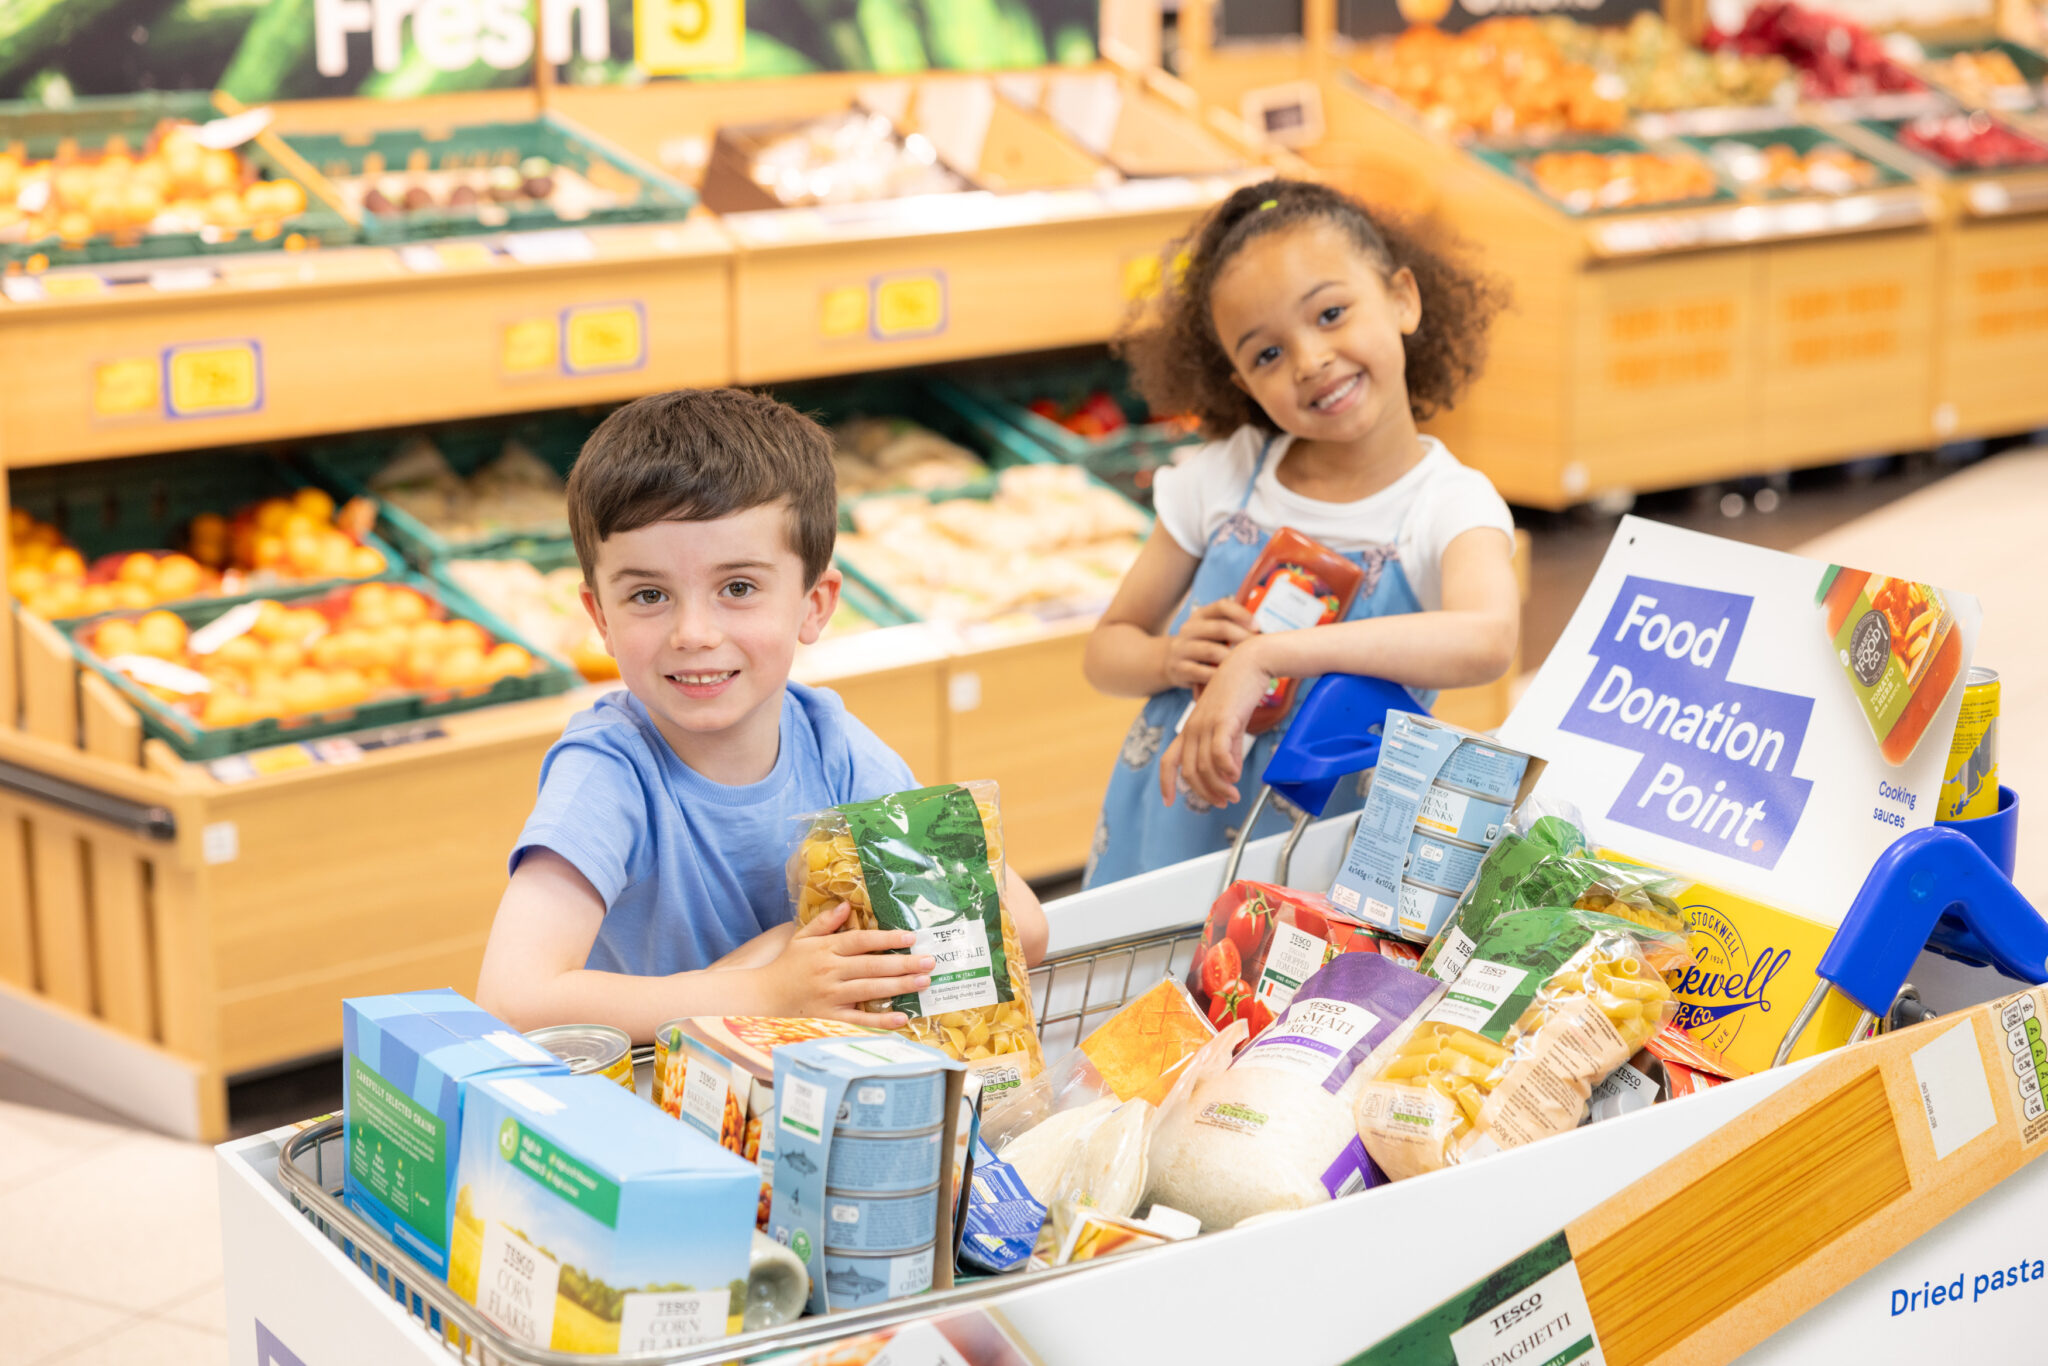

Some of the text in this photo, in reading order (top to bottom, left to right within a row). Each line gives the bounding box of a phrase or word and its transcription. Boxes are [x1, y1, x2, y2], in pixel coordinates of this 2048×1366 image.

[1614, 594, 1730, 669] Food
[1858, 629, 1881, 671] FOOD
[1870, 667, 1895, 705] TOMATO
[1877, 683, 1894, 708] HERB
[1587, 664, 1785, 772] Donation
[1637, 761, 1766, 852] Point.
[1878, 780, 1917, 811] Cooking
[1419, 806, 1454, 823] HUNKS
[1873, 807, 1905, 828] sauces
[1291, 933, 1312, 948] TESCO
[1458, 940, 1473, 957] TES
[1691, 911, 1740, 958] STOCKWELL
[1482, 965, 1507, 977] TESCO
[1710, 954, 1724, 965] 1924
[1668, 946, 1791, 1008] ckwell
[1310, 1001, 1347, 1013] TESCO
[1713, 1028, 1730, 1049] LUE
[699, 1070, 717, 1088] TESCO
[1600, 1079, 1621, 1096] AKED
[1617, 1067, 1642, 1087] TESCO
[356, 1069, 385, 1098] CAREFULLY
[385, 1091, 413, 1120] SELECTED
[413, 1112, 436, 1137] GRAINS
[505, 1242, 535, 1274] TESCO
[497, 1267, 533, 1312] CORN
[1891, 1258, 2045, 1317] Dried pasta
[488, 1287, 537, 1344] FLAKES
[657, 1301, 700, 1314] TESCO
[1490, 1293, 1542, 1330] TESCO
[648, 1319, 701, 1337] CORN
